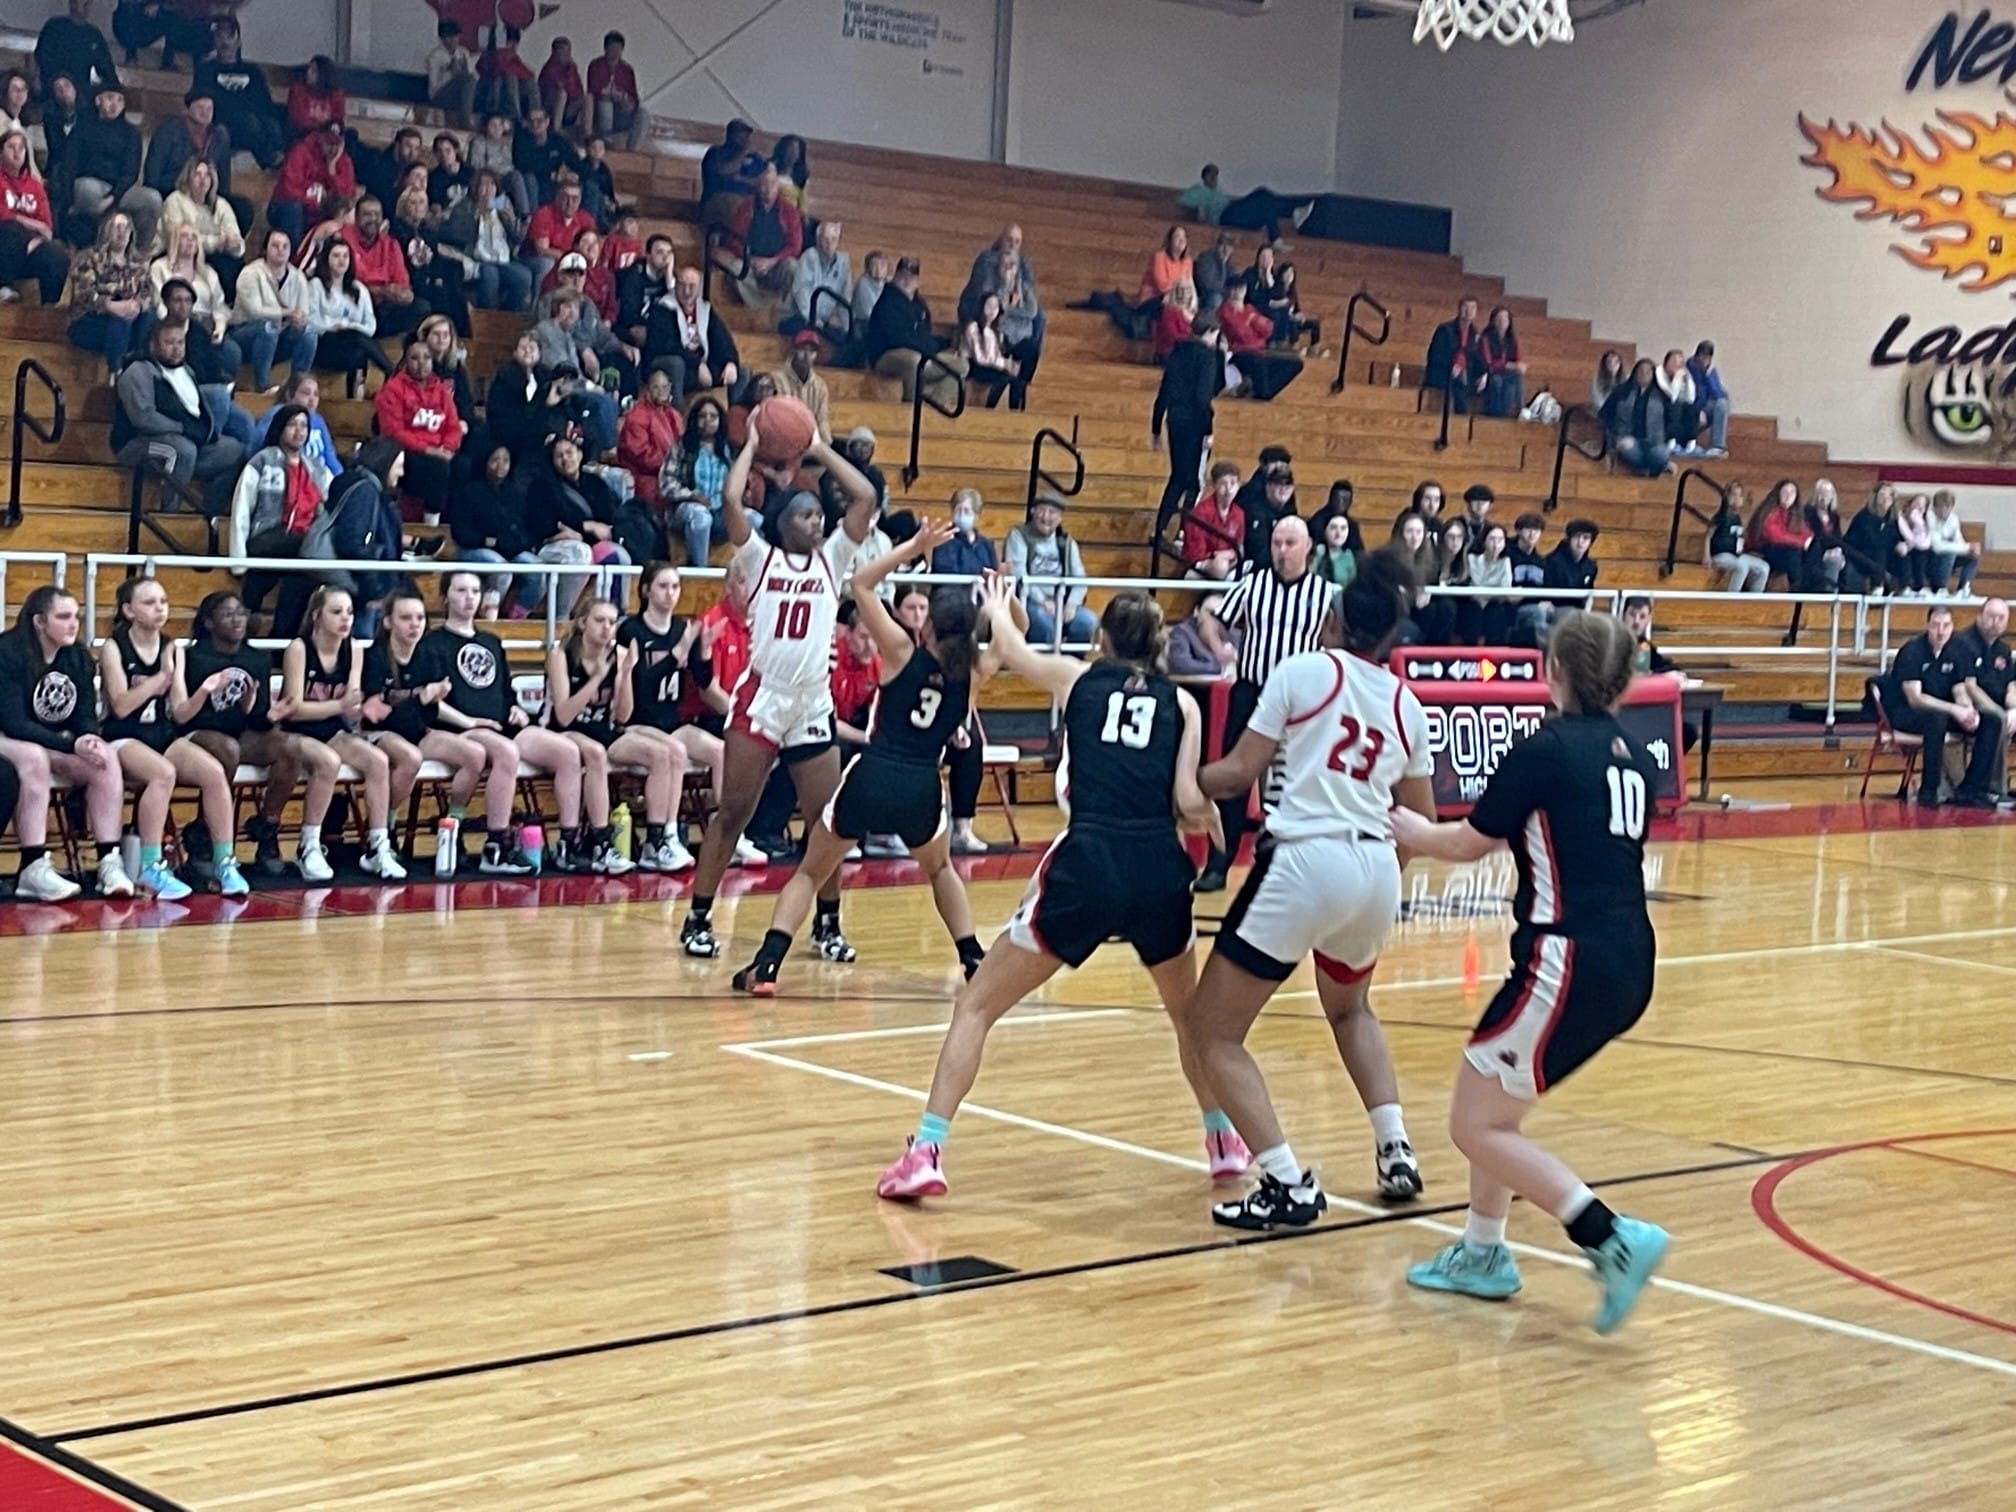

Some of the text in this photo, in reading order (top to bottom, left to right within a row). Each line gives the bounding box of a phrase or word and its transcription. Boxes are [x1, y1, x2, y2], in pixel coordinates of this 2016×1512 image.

[1905, 8, 2016, 93] Ne
[774, 599, 811, 640] 10
[658, 671, 680, 702] 14
[910, 687, 942, 729] 3
[1101, 691, 1157, 750] 13
[1327, 713, 1385, 782] 23
[1606, 765, 1645, 840] 10
